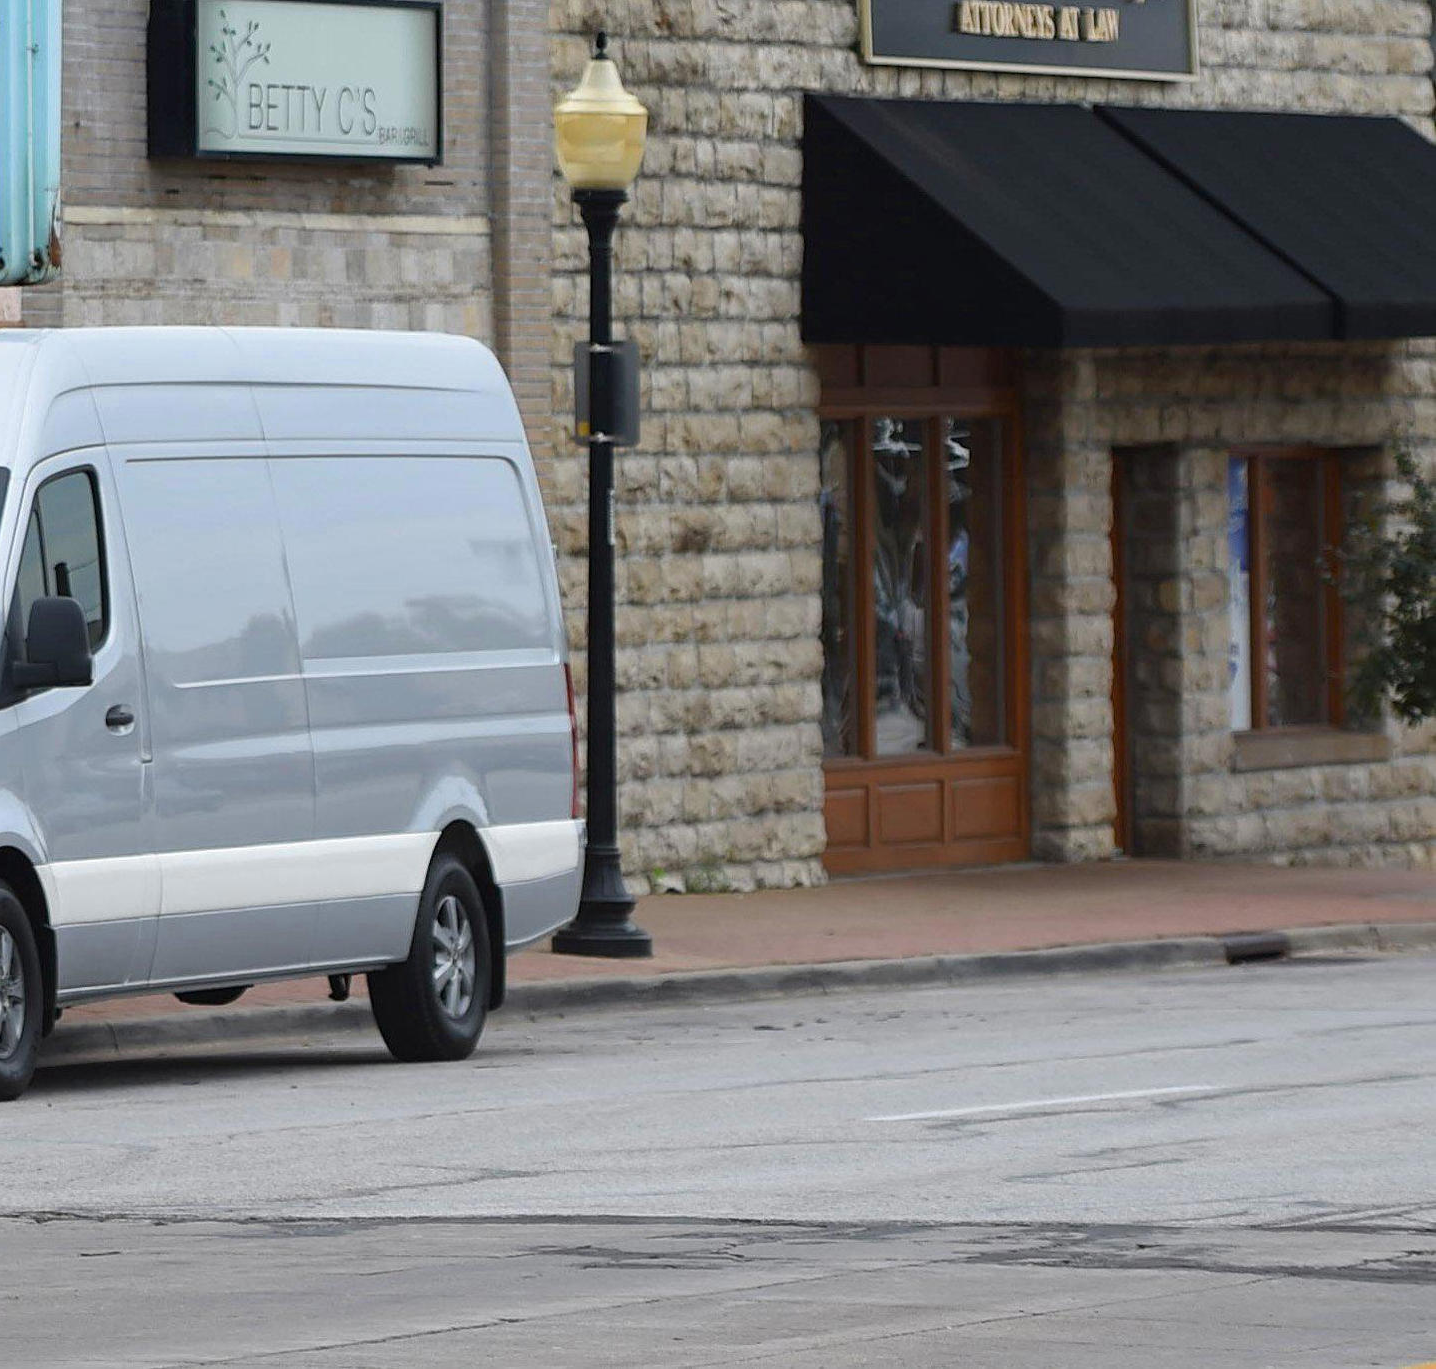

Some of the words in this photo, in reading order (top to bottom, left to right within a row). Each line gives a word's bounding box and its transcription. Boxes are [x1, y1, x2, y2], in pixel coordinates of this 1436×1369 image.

[1059, 5, 1081, 42] AT
[1085, 6, 1120, 43] LAW
[248, 83, 327, 132] BETTY
[337, 86, 377, 137] C'S
